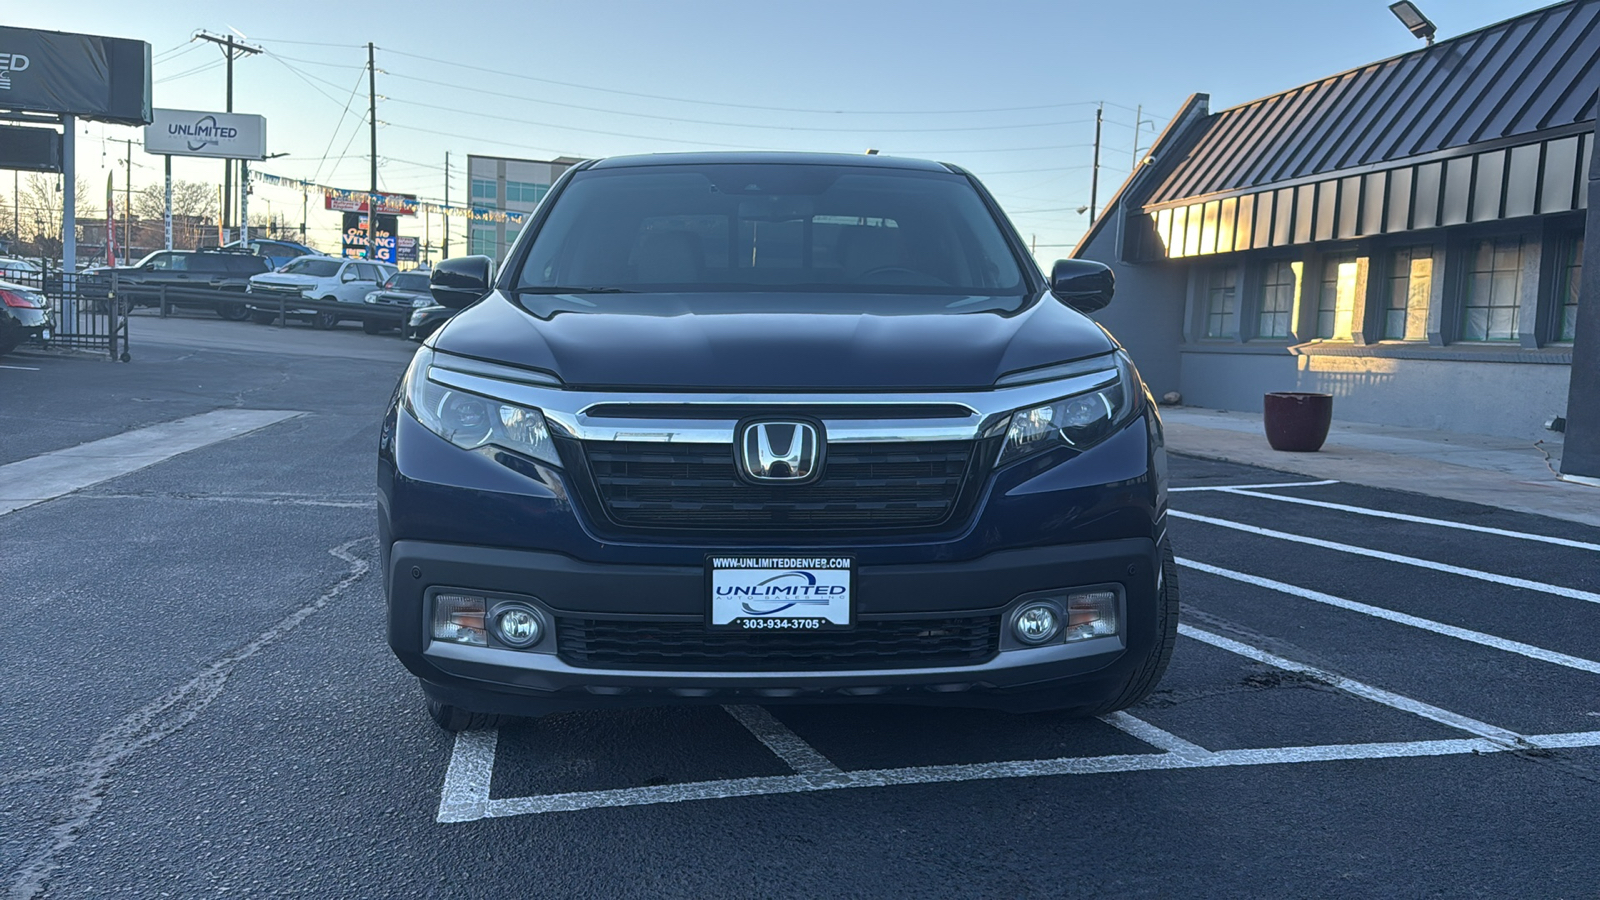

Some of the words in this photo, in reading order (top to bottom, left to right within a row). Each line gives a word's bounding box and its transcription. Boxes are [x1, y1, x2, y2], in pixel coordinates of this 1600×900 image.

[168, 123, 237, 138] UNLIMITED
[343, 233, 395, 248] VIKNG
[716, 585, 847, 596] UNLIMITED
[742, 618, 820, 629] 303-934-3705
